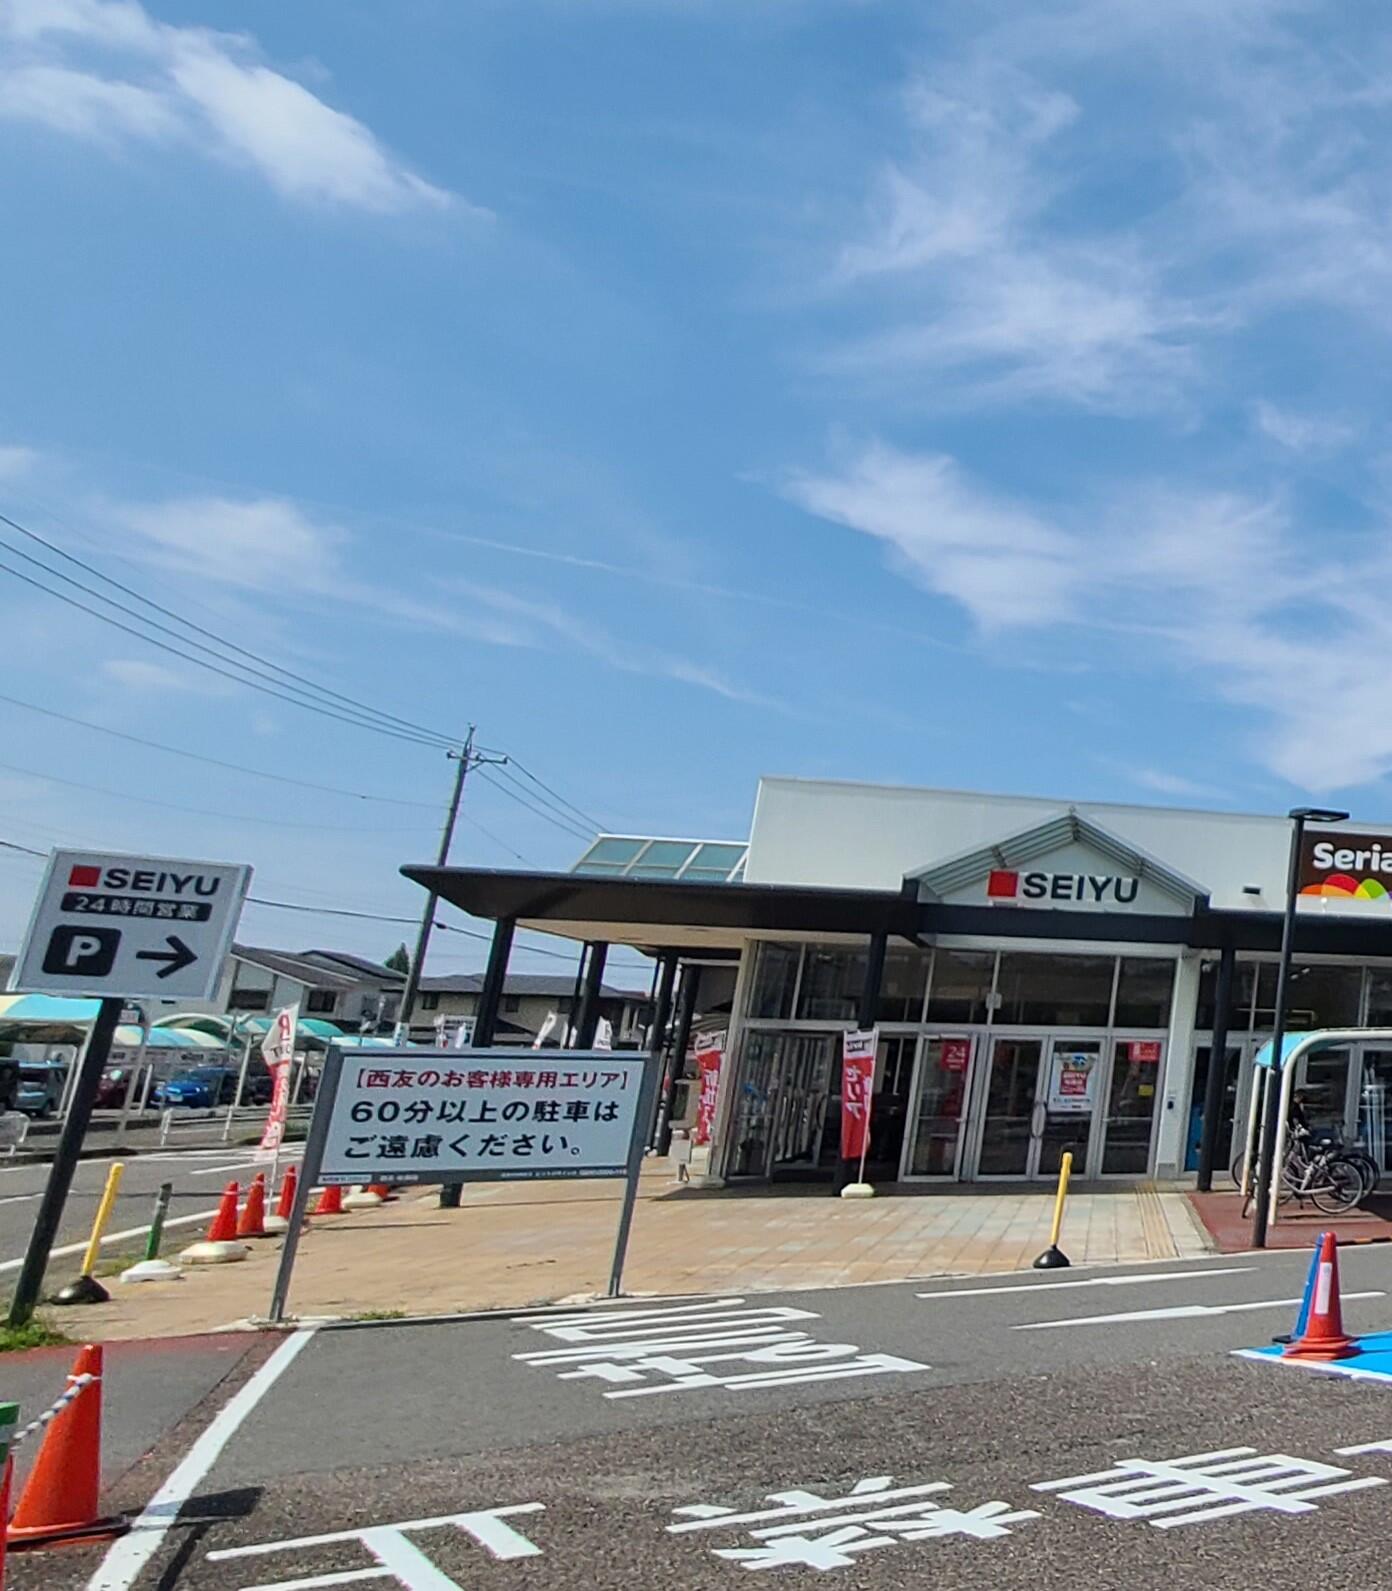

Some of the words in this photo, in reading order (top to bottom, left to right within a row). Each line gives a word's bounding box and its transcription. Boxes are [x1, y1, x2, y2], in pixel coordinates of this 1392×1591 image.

[103, 868, 221, 896] SEIYU
[1022, 872, 1139, 903] SEIYU
[74, 897, 199, 919] 24時間営業
[65, 935, 102, 967] P
[350, 1100, 620, 1124] 60分以上の駐車は
[344, 1134, 581, 1159] ご遠慮ください。
